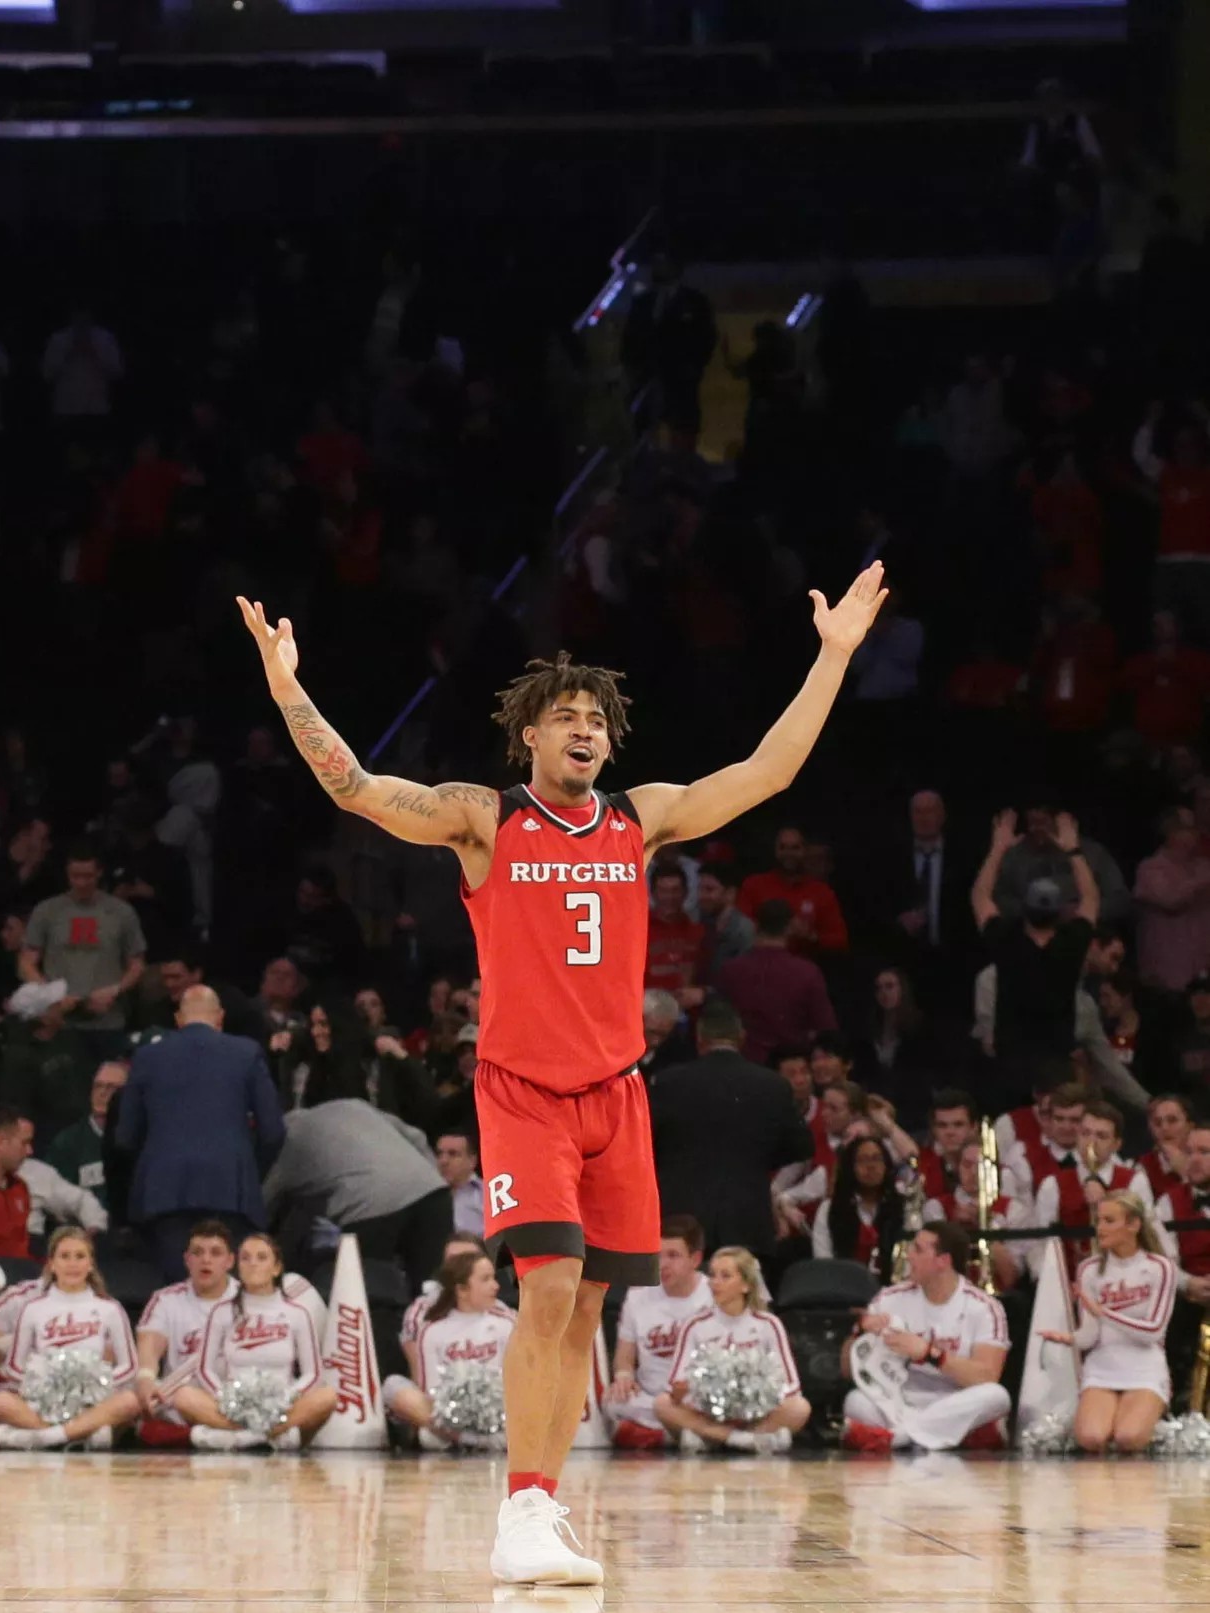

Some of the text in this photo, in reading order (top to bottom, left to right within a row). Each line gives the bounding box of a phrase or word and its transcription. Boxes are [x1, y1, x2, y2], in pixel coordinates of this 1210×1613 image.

[510, 861, 637, 882] RUTGERS
[565, 891, 602, 966] 3
[488, 1172, 519, 1218] R
[322, 1303, 367, 1424] Indiana
